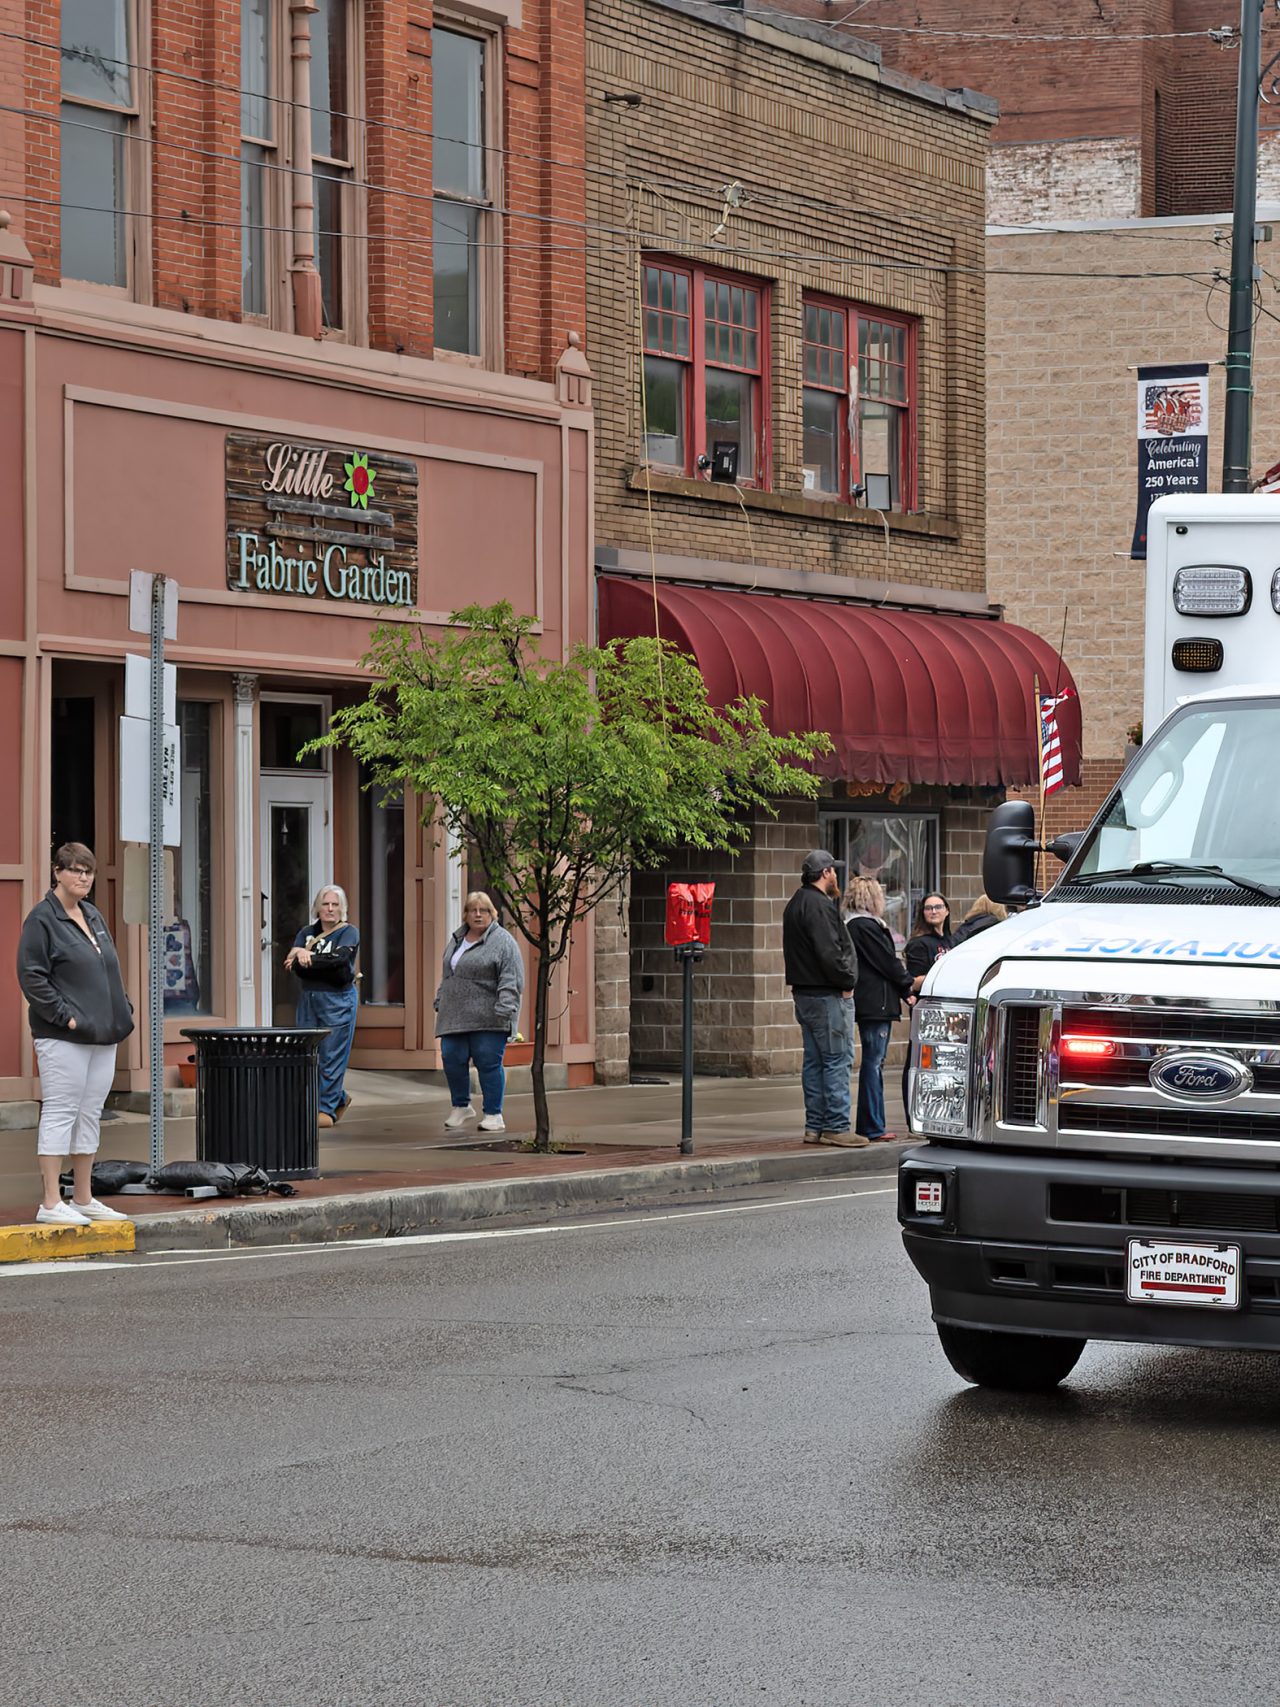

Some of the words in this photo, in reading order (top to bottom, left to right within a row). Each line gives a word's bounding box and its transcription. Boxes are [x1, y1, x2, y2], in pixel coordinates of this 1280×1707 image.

[1145, 439, 1201, 458] Celebrating
[262, 443, 334, 498] Little
[1147, 456, 1199, 470] America!
[1145, 475, 1164, 488] 250
[1165, 474, 1199, 486] Years
[237, 532, 318, 595] Fabric
[323, 545, 413, 605] Garden
[1174, 1065, 1219, 1087] Ford
[1132, 1253, 1158, 1270] CITY
[1159, 1252, 1174, 1264] OF
[1175, 1252, 1236, 1276] BRADFORD
[1140, 1270, 1161, 1281] FIRE
[1164, 1271, 1228, 1285] DEPARTMENT
